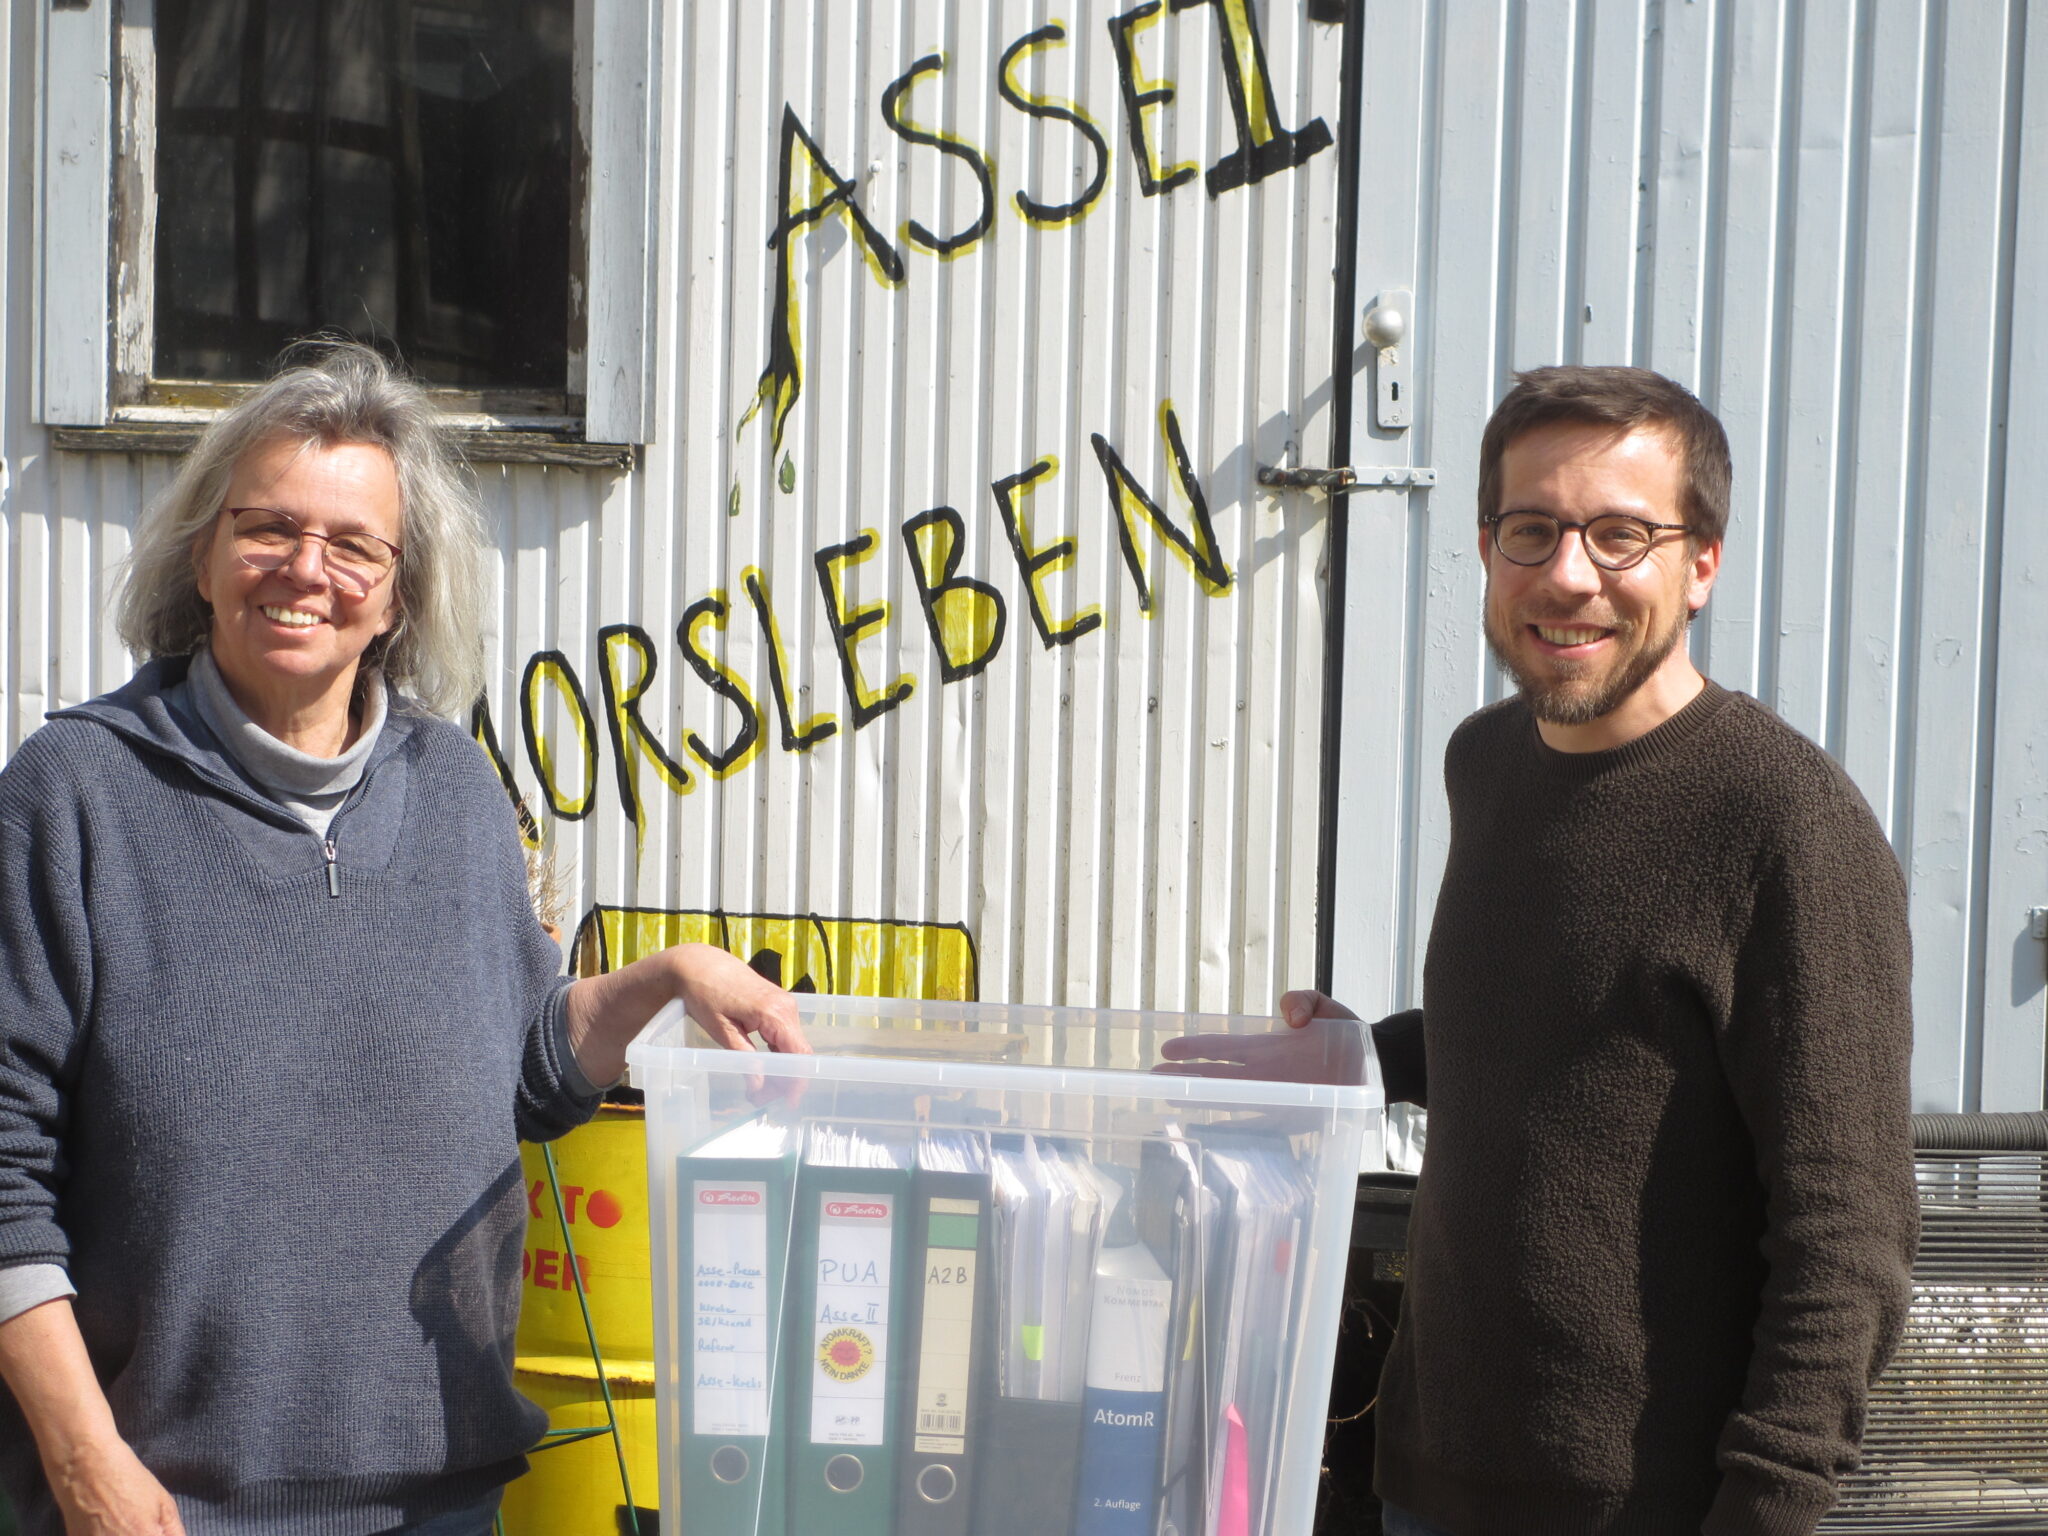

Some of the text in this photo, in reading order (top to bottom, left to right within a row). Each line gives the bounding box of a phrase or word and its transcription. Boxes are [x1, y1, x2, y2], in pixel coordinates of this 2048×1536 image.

[742, 0, 1198, 440] ASSE
[819, 1259, 879, 1285] PUA
[927, 1265, 968, 1285] A2B
[820, 1303, 864, 1324] Asse
[839, 1361, 870, 1381] DANKE
[1114, 1372, 1142, 1384] Frenz
[1093, 1408, 1155, 1428] AtomR
[1104, 1499, 1142, 1512] Auflage
